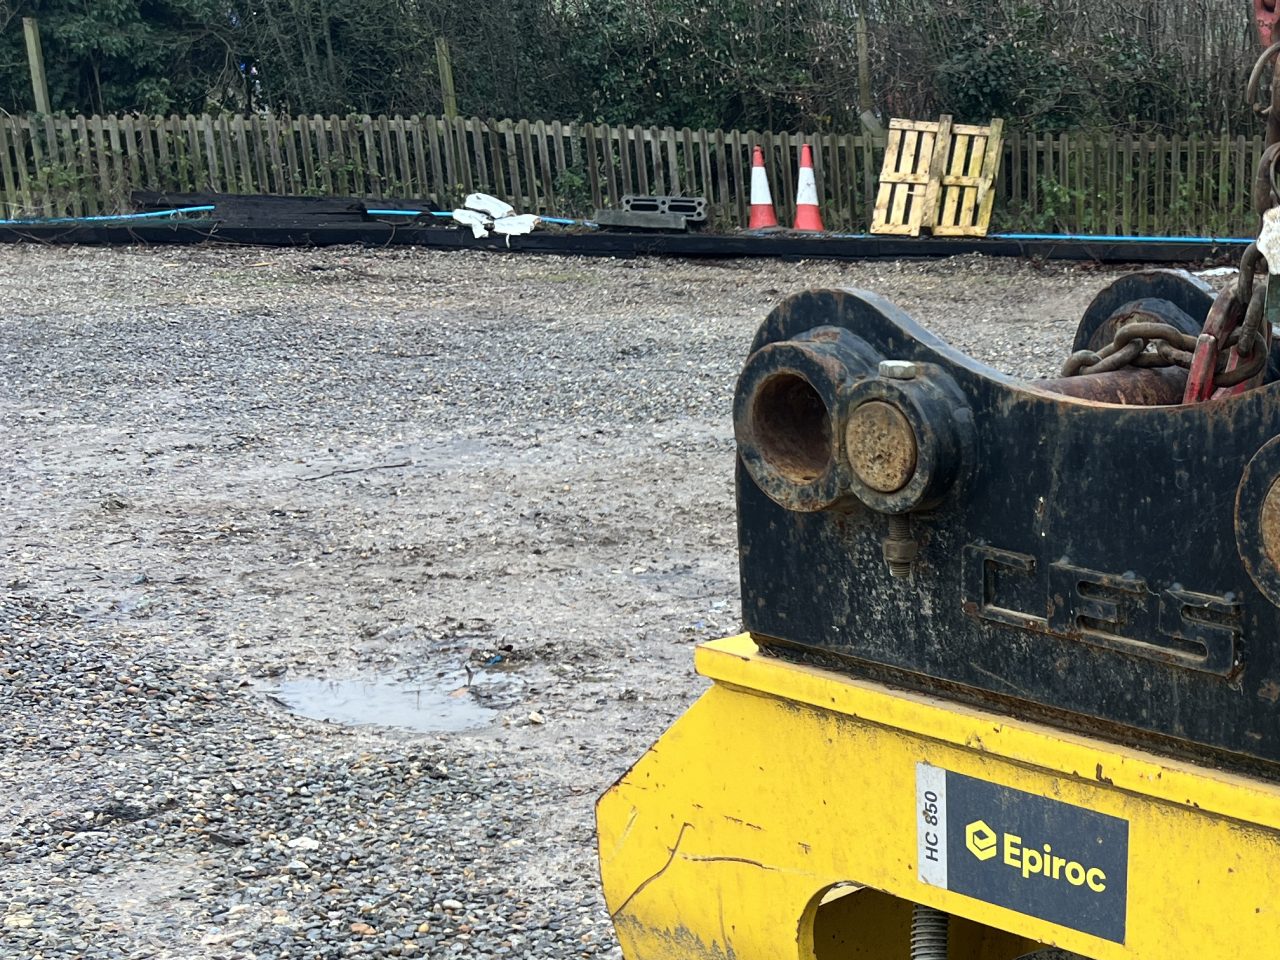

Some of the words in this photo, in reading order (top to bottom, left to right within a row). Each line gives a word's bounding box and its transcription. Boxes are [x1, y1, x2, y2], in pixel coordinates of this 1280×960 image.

[924, 790, 938, 827] 850
[925, 831, 939, 863] HC
[1003, 832, 1107, 893] Epiroc
